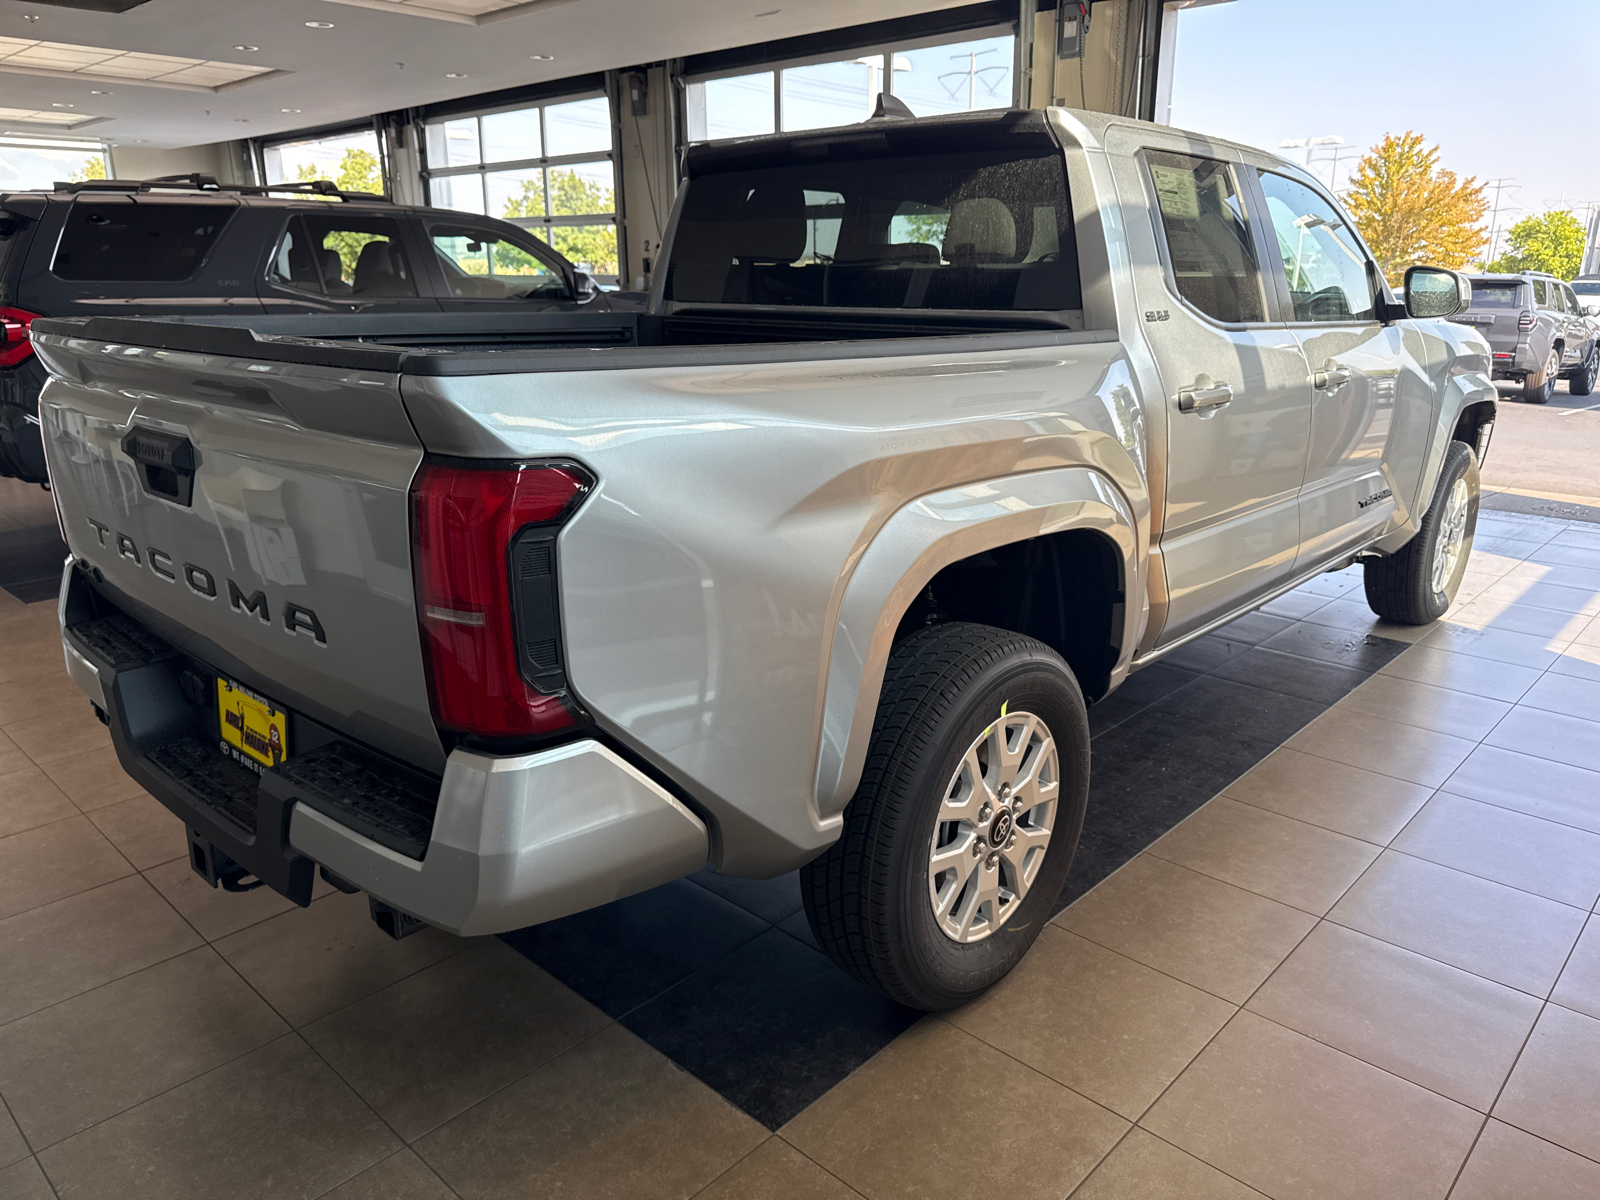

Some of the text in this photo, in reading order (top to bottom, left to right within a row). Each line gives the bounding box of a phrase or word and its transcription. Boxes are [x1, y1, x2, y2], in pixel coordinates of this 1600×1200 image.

[643, 239, 651, 253] 2
[86, 516, 327, 649] TACOMA
[244, 729, 270, 759] MALONE
